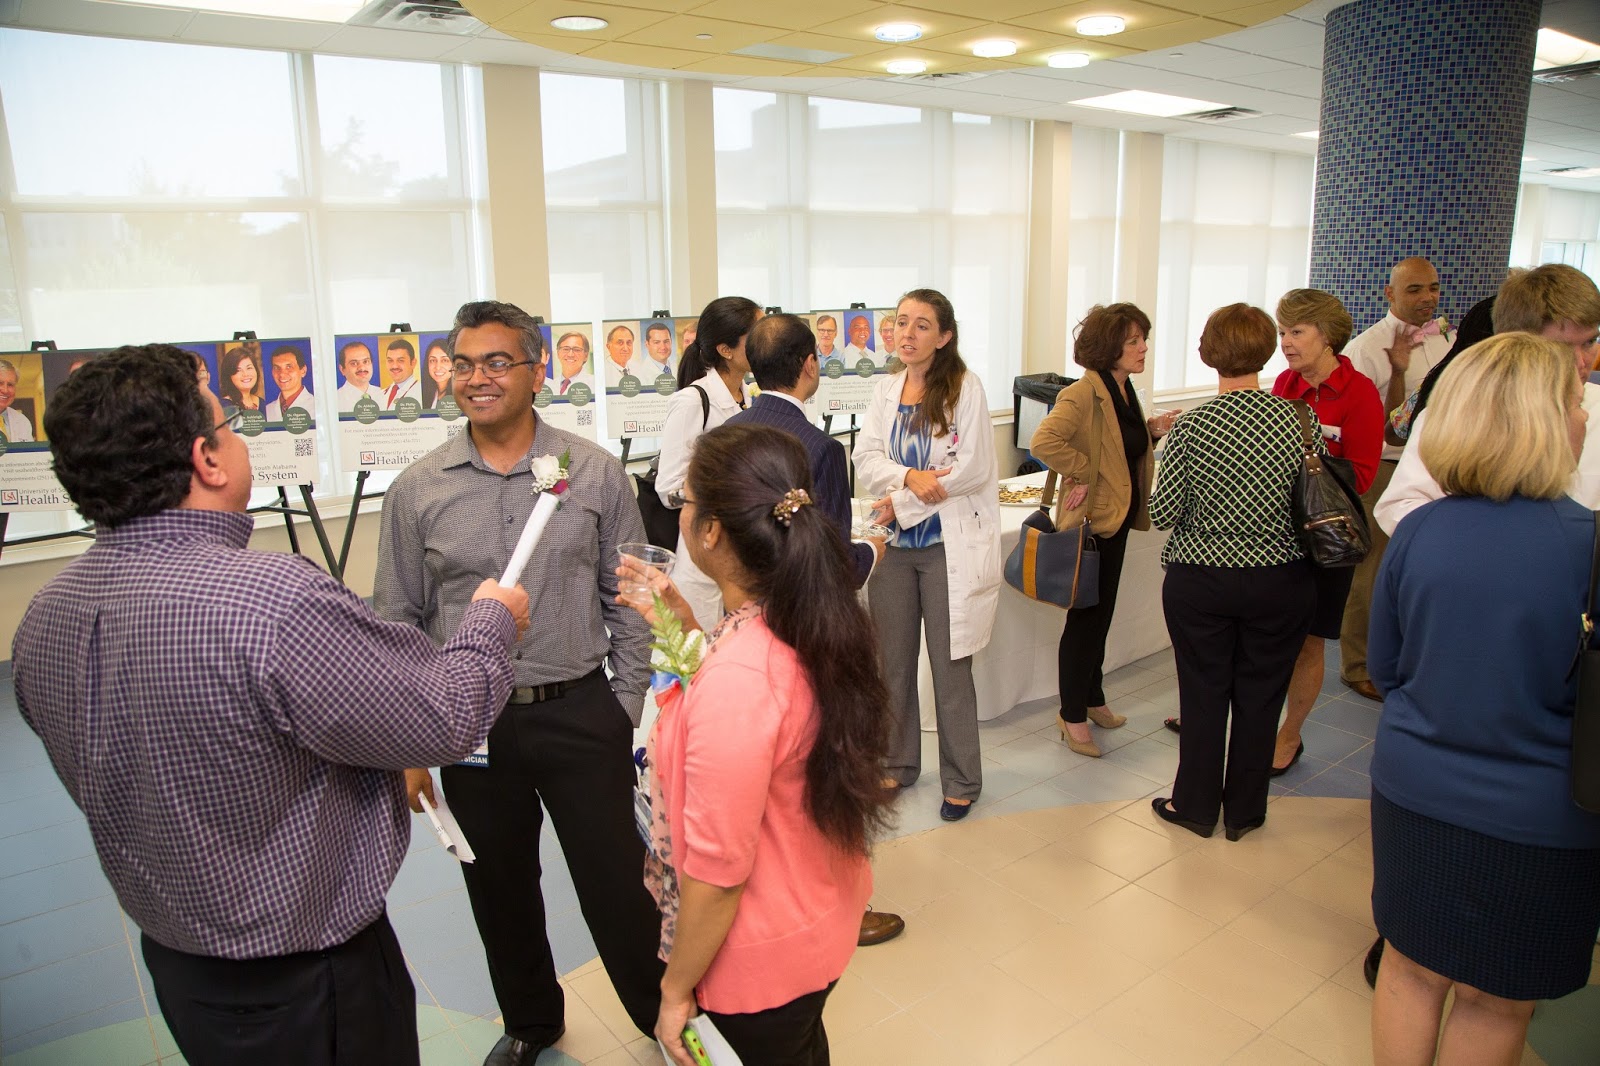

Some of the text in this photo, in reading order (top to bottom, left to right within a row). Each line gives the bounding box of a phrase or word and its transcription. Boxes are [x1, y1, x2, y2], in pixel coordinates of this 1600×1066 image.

[841, 403, 867, 411] Health
[376, 455, 411, 465] Health
[258, 471, 298, 483] System
[20, 494, 59, 505] Health
